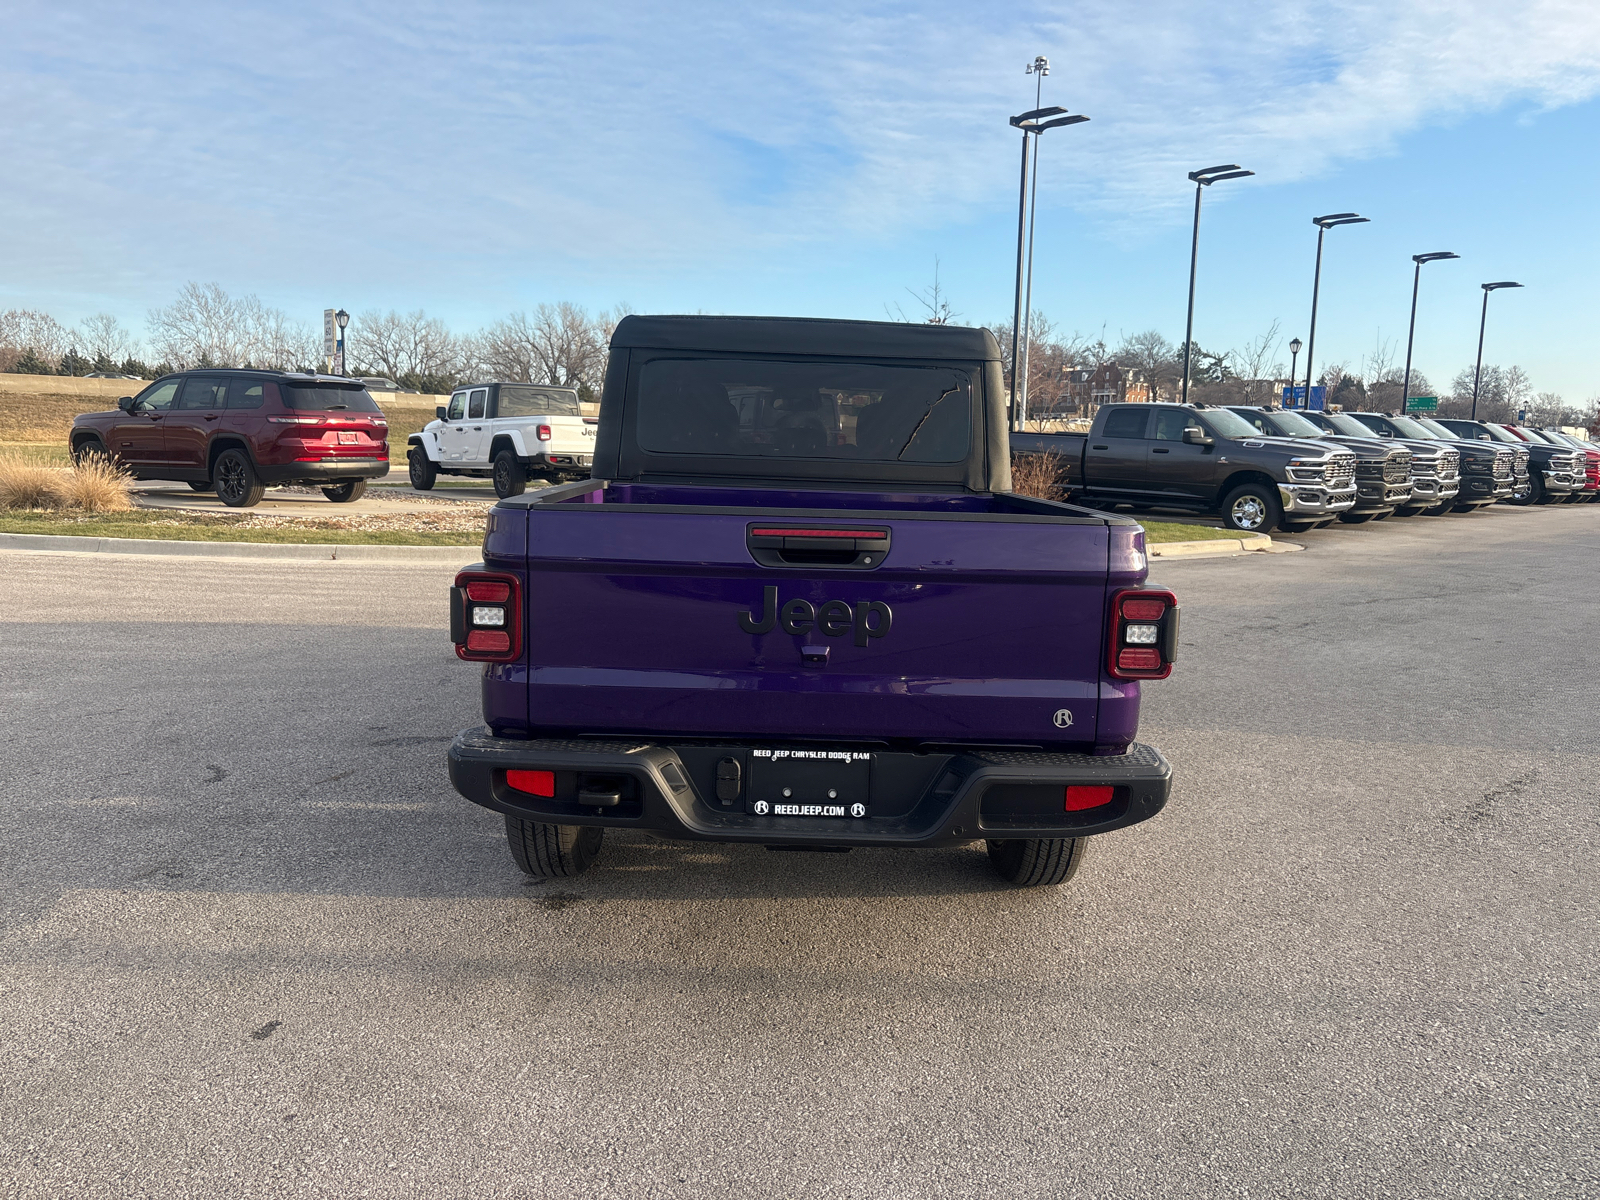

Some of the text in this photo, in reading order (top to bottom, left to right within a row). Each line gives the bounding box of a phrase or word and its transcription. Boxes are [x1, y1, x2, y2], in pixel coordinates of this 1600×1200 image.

[581, 427, 597, 436] Jee
[737, 585, 893, 648] Jeep
[753, 749, 870, 760] REED JEEP CHRYSLER DODGE RAM
[774, 804, 845, 816] REEDJEEP.COM
